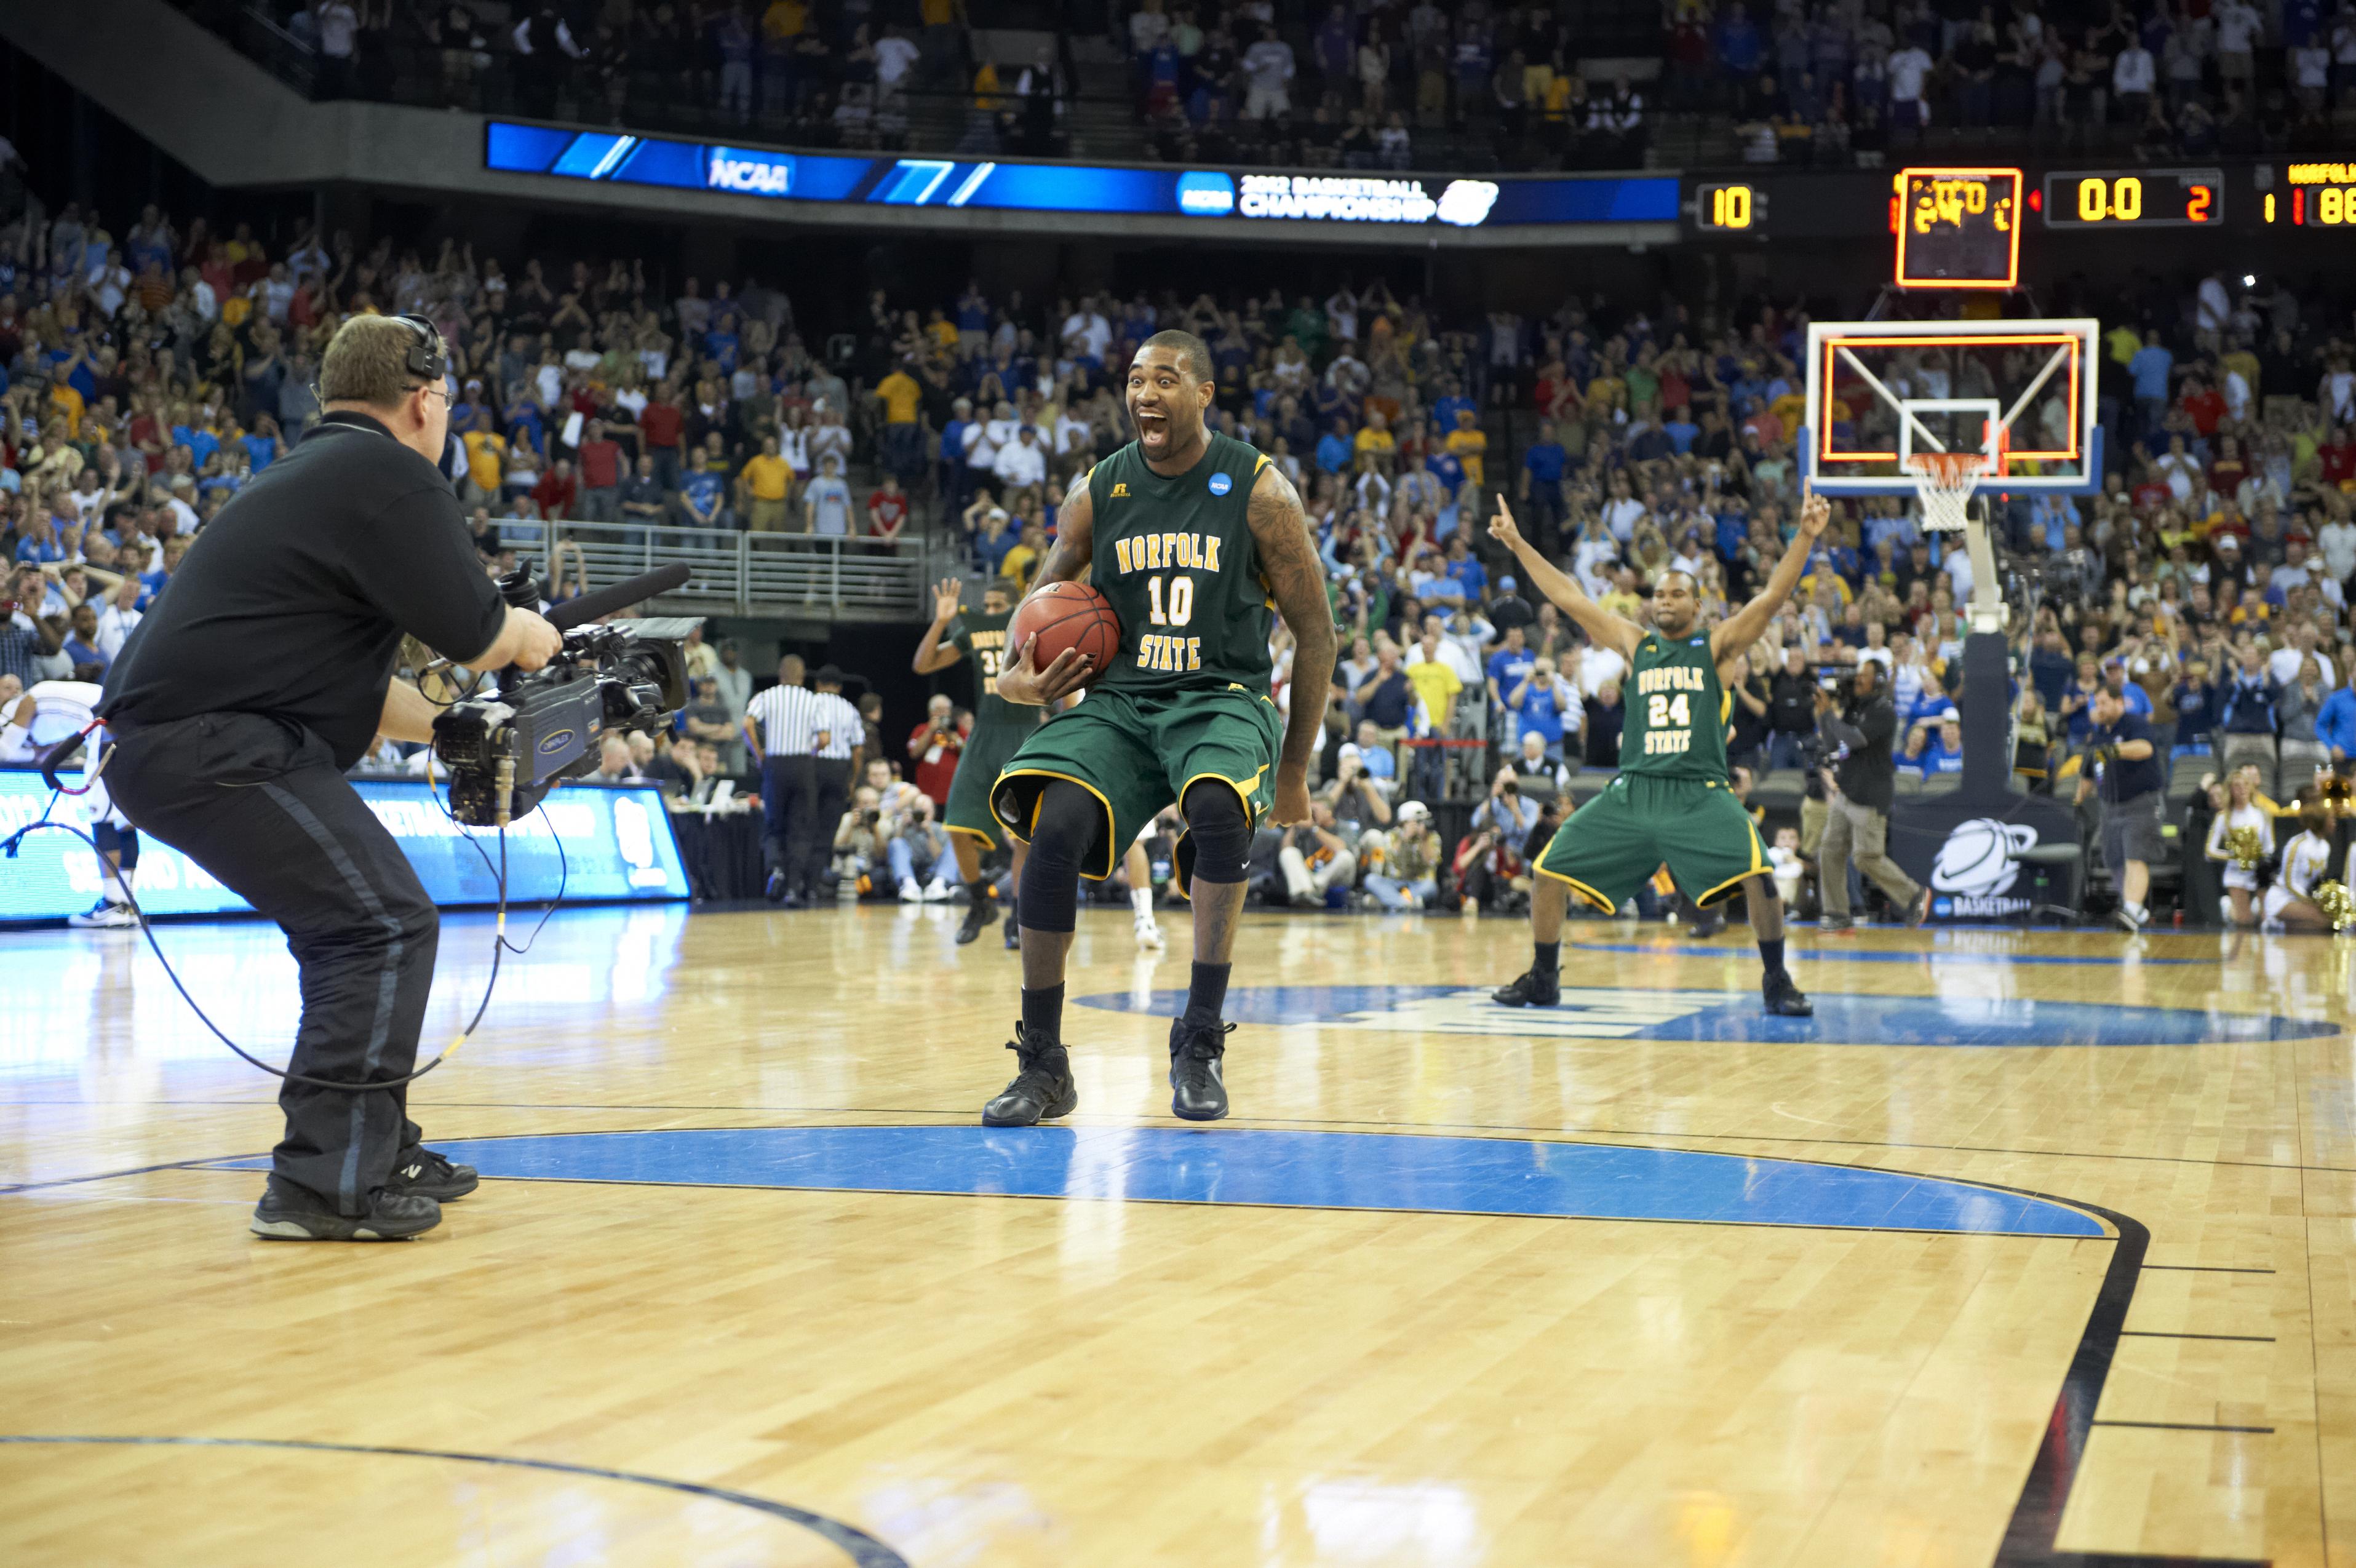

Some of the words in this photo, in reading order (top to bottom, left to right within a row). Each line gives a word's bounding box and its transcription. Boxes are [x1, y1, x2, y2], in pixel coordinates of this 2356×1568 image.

[709, 159, 789, 193] NCAA
[1241, 175, 1291, 195] 2012
[1292, 177, 1428, 200] BASKETBALL
[1240, 193, 1437, 223] CHAMPIONSHIP
[1714, 186, 1751, 228] 10
[2079, 178, 2141, 221] 0.0
[2187, 186, 2211, 222] 2
[1211, 482, 1228, 490] NCAA
[1115, 532, 1220, 574] NORFOLK
[1148, 576, 1193, 626] 10
[970, 630, 1006, 650] NORFO
[1137, 634, 1201, 671] STATE
[1638, 666, 1705, 696] NORFOLK
[1649, 693, 1690, 727] 24
[1644, 730, 1692, 755] STATE
[62, 850, 179, 893] SEND
